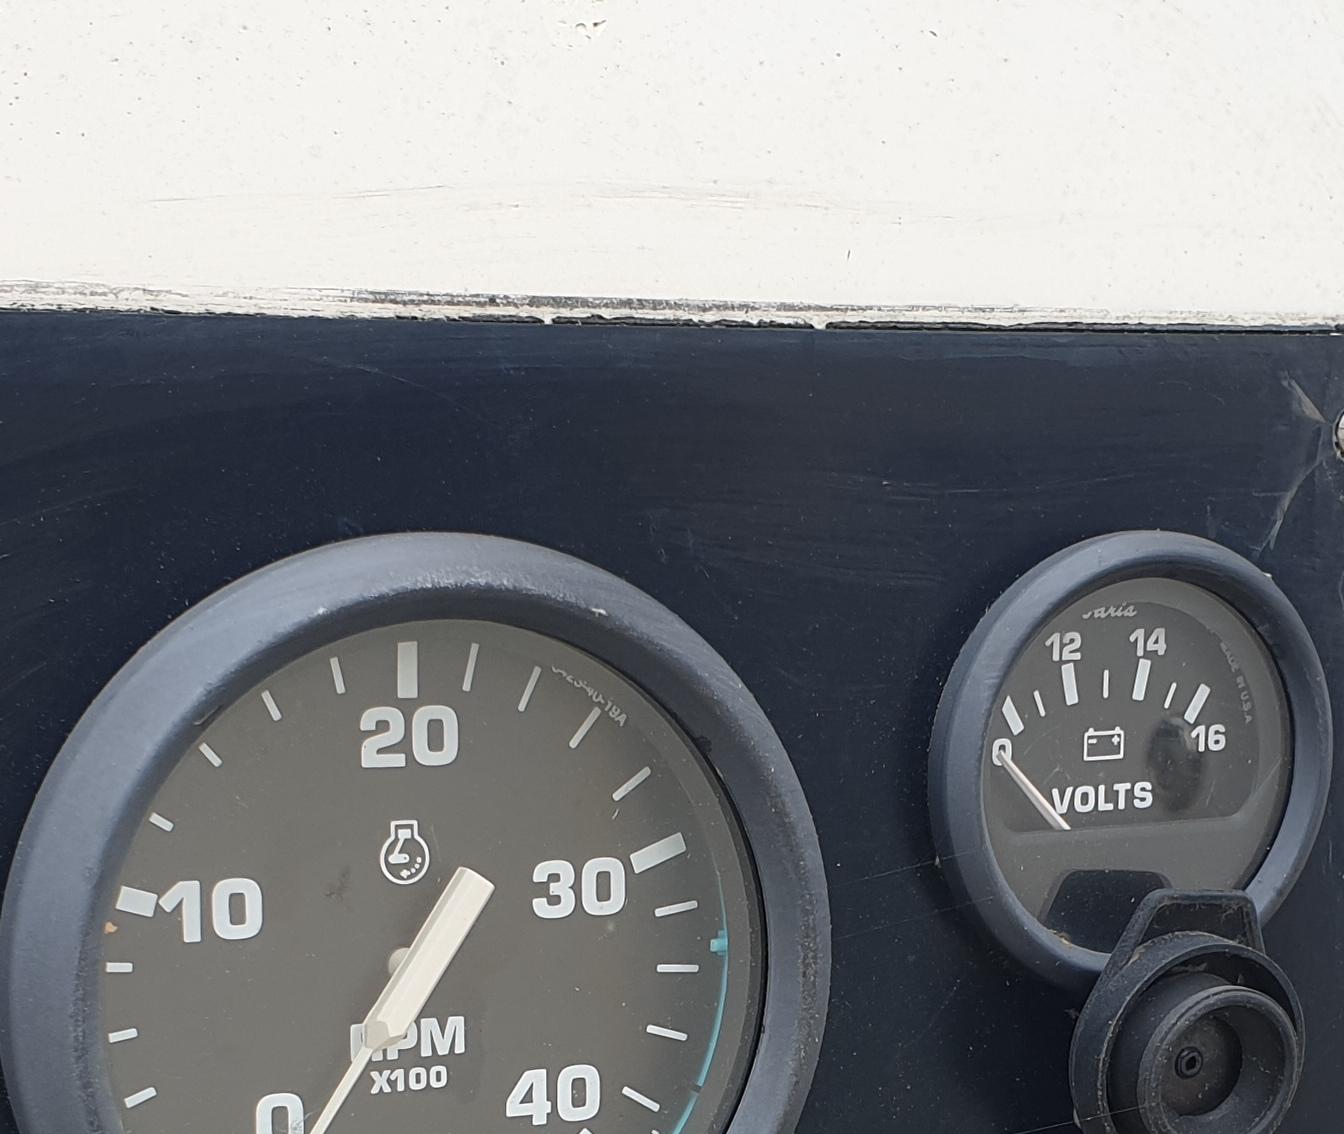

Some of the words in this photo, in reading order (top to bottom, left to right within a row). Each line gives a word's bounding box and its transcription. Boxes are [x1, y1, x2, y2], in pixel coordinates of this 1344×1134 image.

[1044, 631, 1082, 662] 12
[1128, 627, 1167, 657] 14
[358, 705, 459, 768] 20
[991, 738, 1012, 767] 0
[1190, 724, 1227, 752] 16
[1051, 781, 1154, 814] VOLTS
[531, 856, 626, 920] 30
[159, 876, 262, 943] 10
[369, 1064, 449, 1095] X100
[505, 1064, 601, 1126] 40
